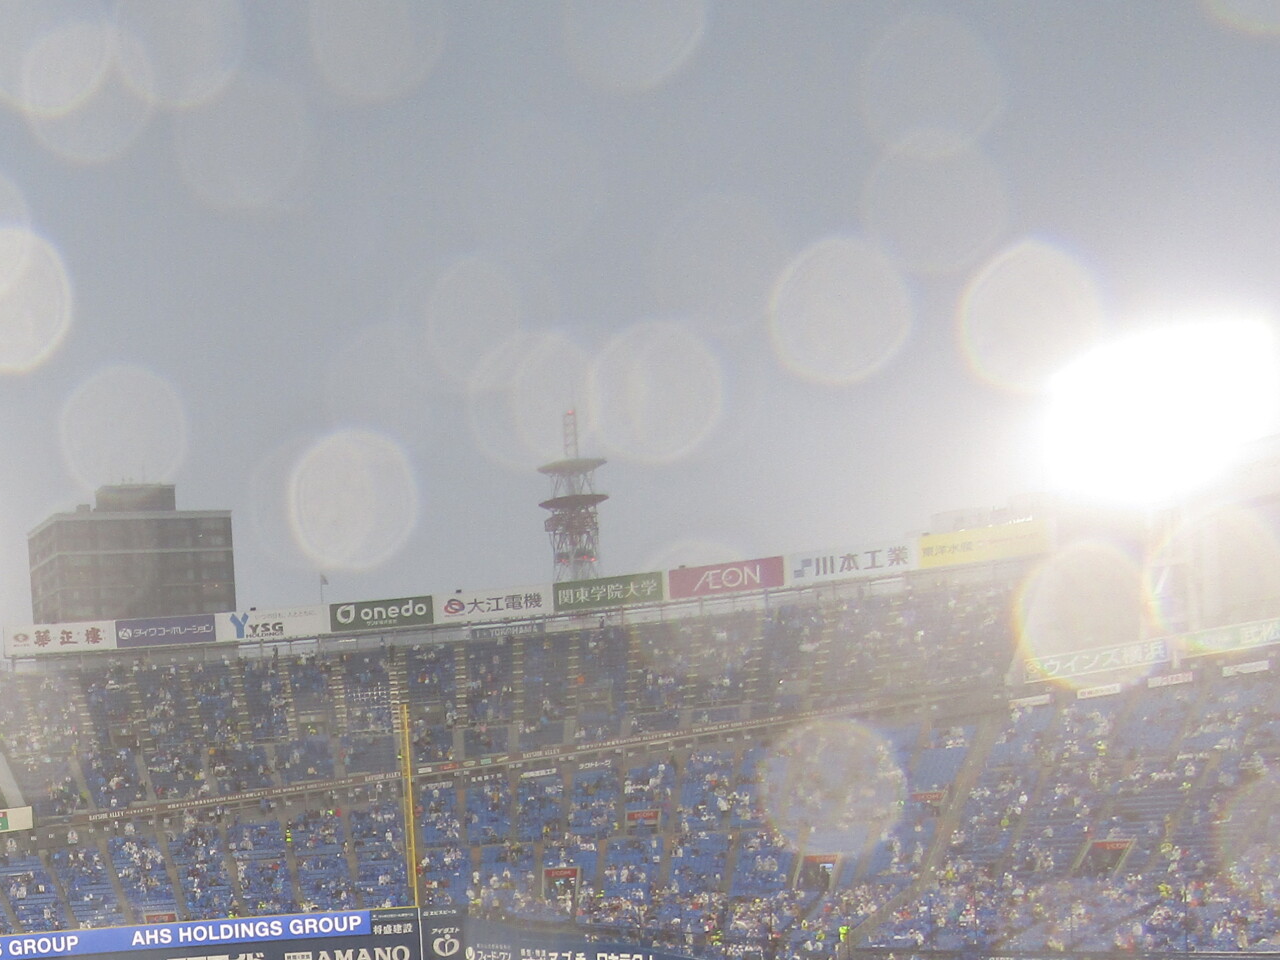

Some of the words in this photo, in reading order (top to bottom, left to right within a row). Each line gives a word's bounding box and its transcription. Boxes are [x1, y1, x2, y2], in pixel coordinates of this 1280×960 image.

[815, 546, 909, 576] 川本工業
[558, 579, 658, 605] 関東学院大学
[361, 600, 427, 620] onedo
[467, 593, 543, 615] 大江電機
[249, 622, 284, 633] YSG
[132, 928, 172, 946] AHS
[179, 920, 283, 943] HOLDINGS
[289, 915, 362, 936] GROUP
[8, 935, 79, 956] GROUP
